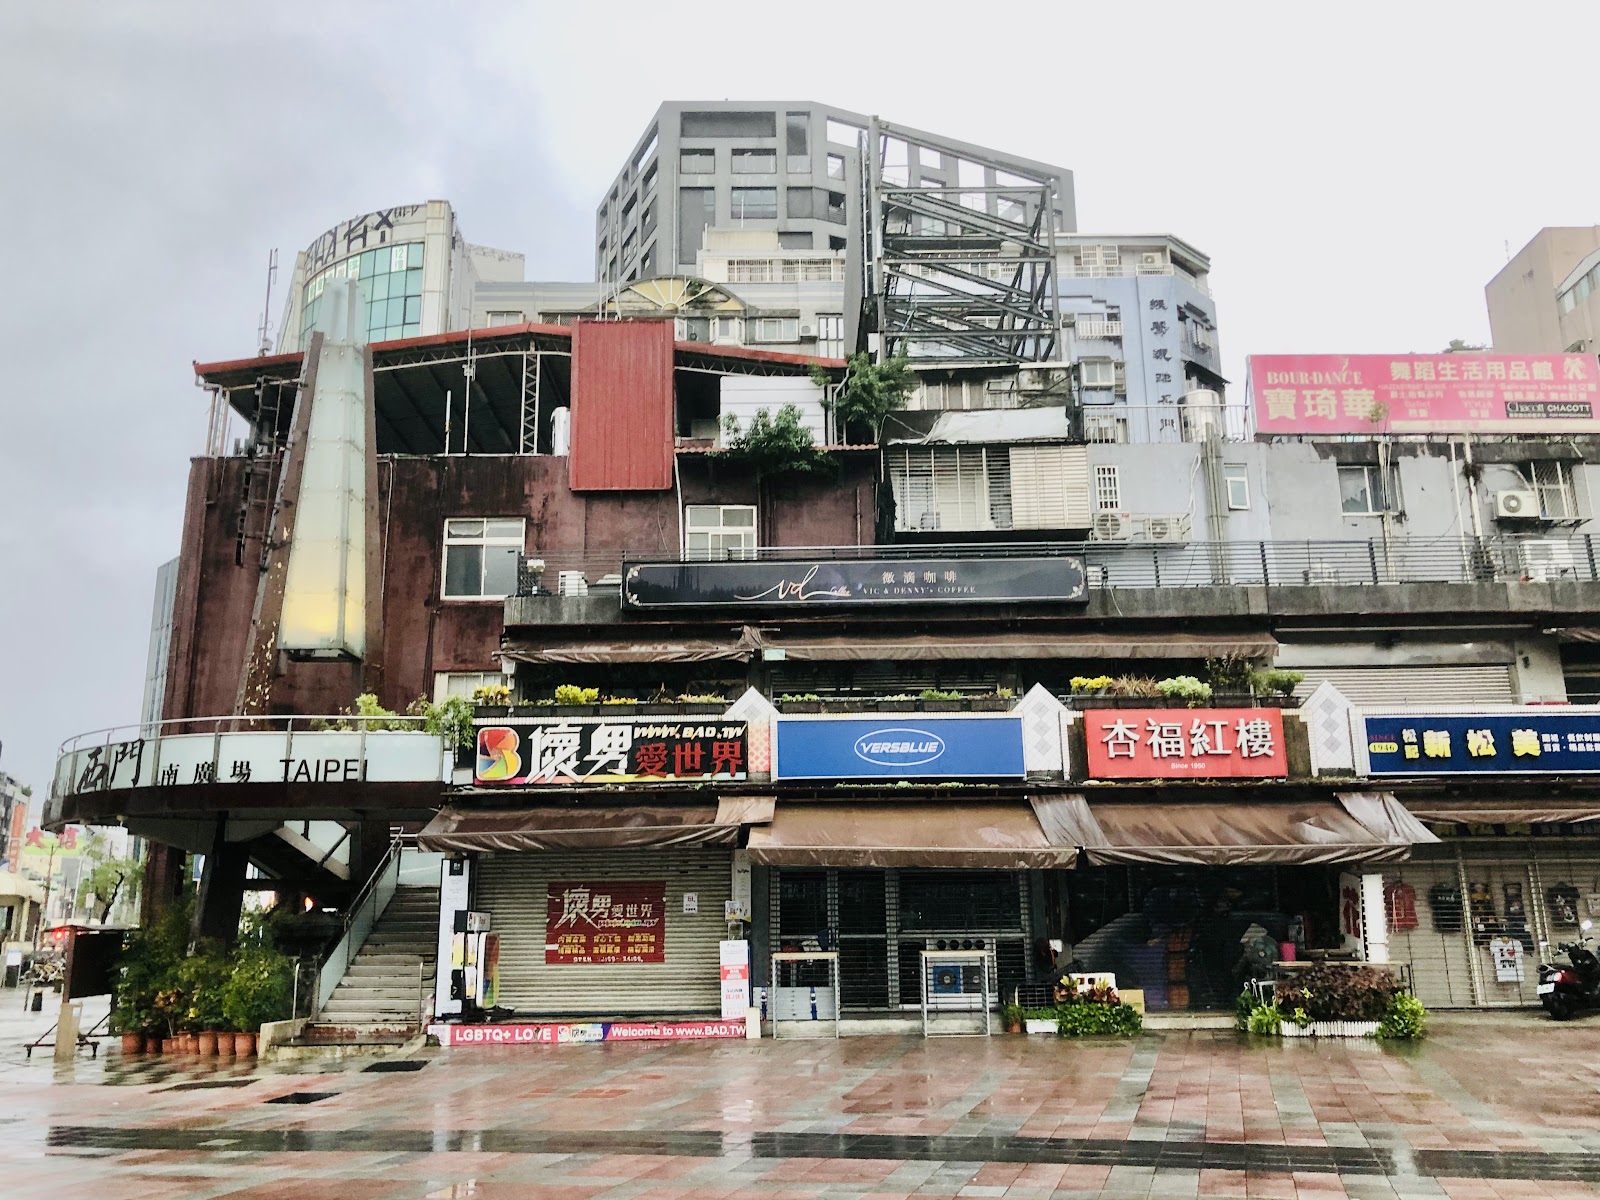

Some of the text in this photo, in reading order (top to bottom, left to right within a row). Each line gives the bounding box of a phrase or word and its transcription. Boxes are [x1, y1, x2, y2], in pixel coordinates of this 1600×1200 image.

[1390, 361, 1554, 381] 舞蹈生活用品館
[1262, 387, 1376, 420] 寶琦華
[1547, 404, 1591, 412] CHACOTT
[937, 586, 976, 594] COFFEE
[633, 724, 747, 740] WWW.BAD.TW
[1102, 717, 1275, 759] 杏福紅樓
[860, 741, 939, 754] VERSBLUE
[77, 739, 368, 795] 西門 南廣場 TAIPEI
[635, 741, 743, 778] 愛世界
[611, 903, 653, 918] 愛世界
[455, 1028, 511, 1042] LGBTQ+
[514, 1027, 552, 1041] LOVE
[611, 1026, 660, 1037] Welcome
[662, 1026, 673, 1036] to
[675, 1025, 746, 1036] www.BAD.TW
